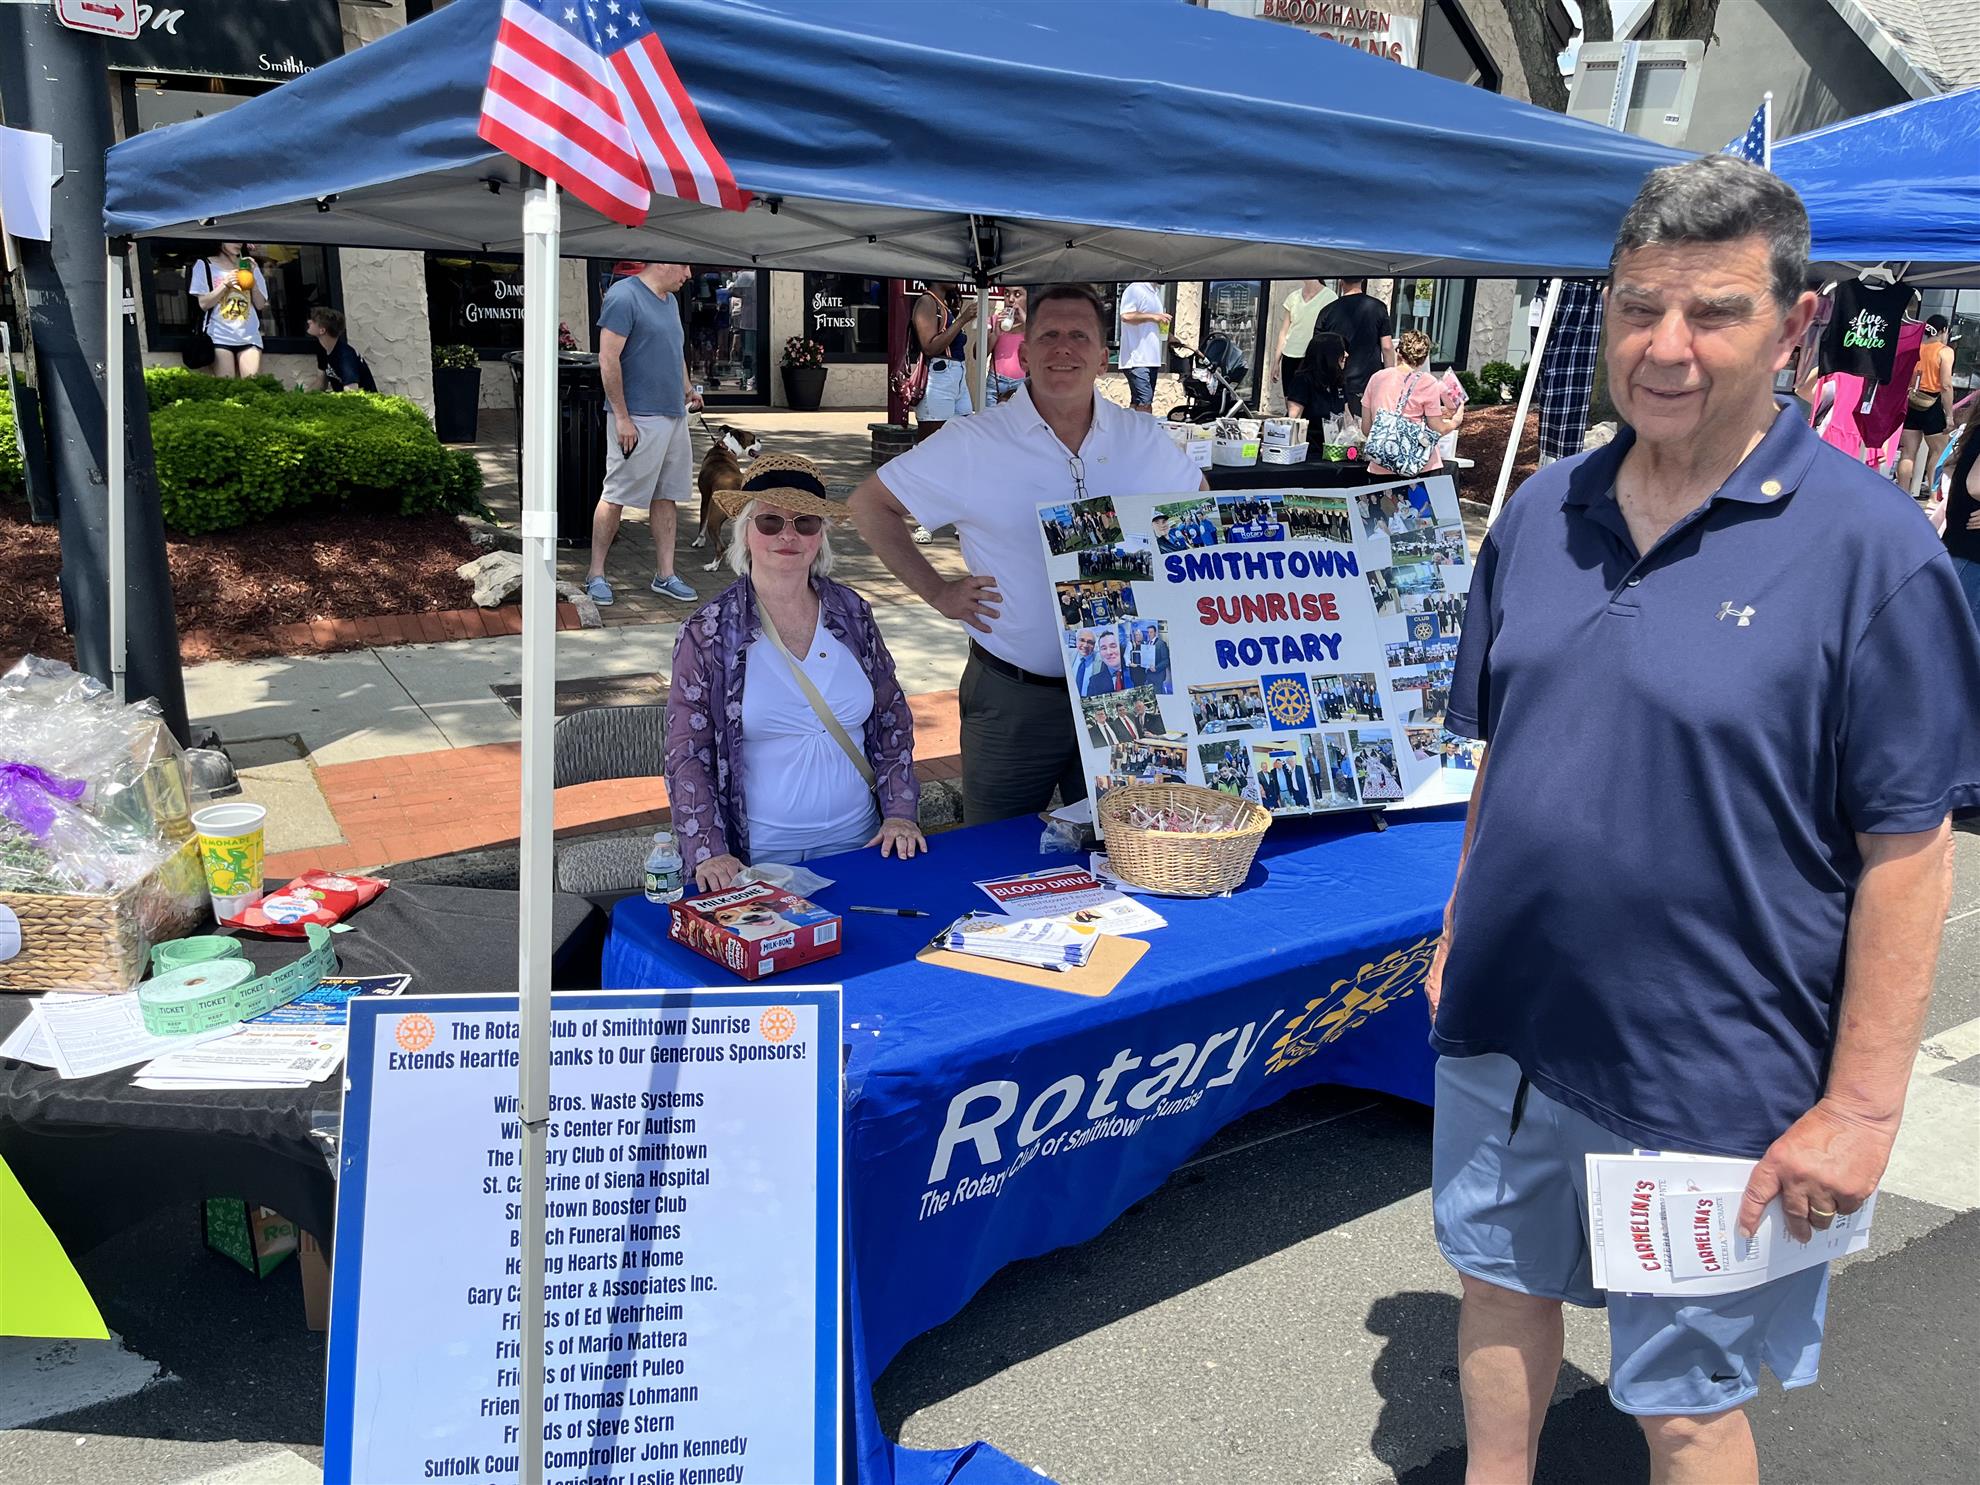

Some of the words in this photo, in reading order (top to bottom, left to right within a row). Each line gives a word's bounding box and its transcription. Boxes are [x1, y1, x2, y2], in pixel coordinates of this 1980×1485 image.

[1263, 0, 1391, 33] BROOKHAVEN
[258, 53, 315, 74] Smithto
[494, 279, 524, 299] DANC
[465, 302, 525, 323] GYMNASTIC
[812, 292, 843, 311] SKATE
[813, 313, 856, 331] FITNESS
[1856, 308, 1881, 325] Live
[1843, 330, 1886, 349] Dance
[1164, 550, 1360, 584] SMITHTOWN
[1196, 592, 1340, 626] SUNRISE
[1214, 632, 1343, 670] ROTARY
[992, 882, 1047, 897] BLOOD
[1046, 875, 1094, 889] DRIVE
[696, 886, 765, 911] MILK-BONE
[762, 935, 794, 953] MILK-BONE
[274, 969, 295, 984] TICKET
[240, 983, 264, 997] TICKET
[159, 1005, 185, 1015] TICKET
[198, 996, 227, 1010] TICKET
[452, 1022, 480, 1040] The
[485, 1021, 519, 1039] Rota
[549, 1020, 577, 1038] lub
[582, 1019, 598, 1037] of
[602, 1017, 687, 1037] Smithtown
[691, 1016, 750, 1034] Sunrise
[389, 1051, 455, 1070] Extends
[460, 1050, 519, 1068] Heartfe
[549, 1047, 593, 1067] anks
[598, 1047, 614, 1065] to
[619, 1046, 645, 1064] Our
[650, 1044, 724, 1063] Generous
[729, 1042, 806, 1063] Sponsors!
[549, 1094, 586, 1112] Bros.
[591, 1093, 637, 1110] Waste
[641, 1091, 704, 1110] Systems
[927, 1009, 1285, 1185] Rotary
[563, 1119, 613, 1138] Center
[617, 1118, 641, 1136] For
[644, 1117, 696, 1135] Autism
[487, 1149, 514, 1167] The
[572, 1146, 605, 1164] Club
[609, 1145, 624, 1162] of
[628, 1143, 708, 1162] Smithtown
[919, 1189, 950, 1222] The
[952, 1166, 1011, 1206] Rotary
[1008, 1138, 1041, 1178] Club
[1041, 1131, 1069, 1157] of
[1063, 1115, 1145, 1152] Smithtown
[1150, 1089, 1204, 1121] Sunrise
[483, 1177, 503, 1194] St.
[507, 1173, 580, 1193] Caerine
[585, 1172, 600, 1190] of
[604, 1170, 645, 1189] Siena
[649, 1168, 710, 1188] Hospital
[592, 1198, 651, 1216] Booster
[655, 1195, 688, 1213] Club
[569, 1225, 625, 1244] Funeral
[629, 1224, 681, 1241] Homes
[1630, 1180, 1662, 1271] CARMELINA'S
[1693, 1198, 1721, 1272] CARMELINA'S
[505, 1256, 563, 1275] Heng
[568, 1252, 618, 1272] Hearts
[622, 1250, 638, 1269] At
[641, 1250, 684, 1268] Home
[467, 1286, 503, 1306] Gary
[507, 1282, 585, 1303] Caenter
[588, 1280, 598, 1298] &
[602, 1276, 687, 1297] Associates
[690, 1274, 718, 1292] Inc.
[502, 1310, 560, 1331] Frids
[564, 1308, 580, 1327] of
[584, 1307, 601, 1326] Ed
[606, 1302, 684, 1325] Wehrheim
[496, 1339, 554, 1360] Fries
[558, 1336, 574, 1355] of
[578, 1333, 623, 1354] Mario
[627, 1331, 688, 1351] Mattera
[497, 1366, 555, 1388] Fris
[560, 1364, 575, 1383] of
[580, 1360, 637, 1382] Vincent
[642, 1358, 685, 1377] Puleo
[480, 1397, 519, 1417] Frien
[544, 1393, 559, 1413] of
[563, 1390, 625, 1411] Thomas
[629, 1385, 698, 1407] Lohmann
[504, 1422, 562, 1444] Frds
[566, 1420, 582, 1439] of
[586, 1417, 630, 1437] Steve
[634, 1414, 675, 1434] Stern
[424, 1456, 481, 1478] Suffolk
[544, 1446, 637, 1470] Comptroller
[640, 1441, 679, 1462] John
[683, 1435, 748, 1458] Kennedy
[679, 1463, 744, 1485] Kennedy
